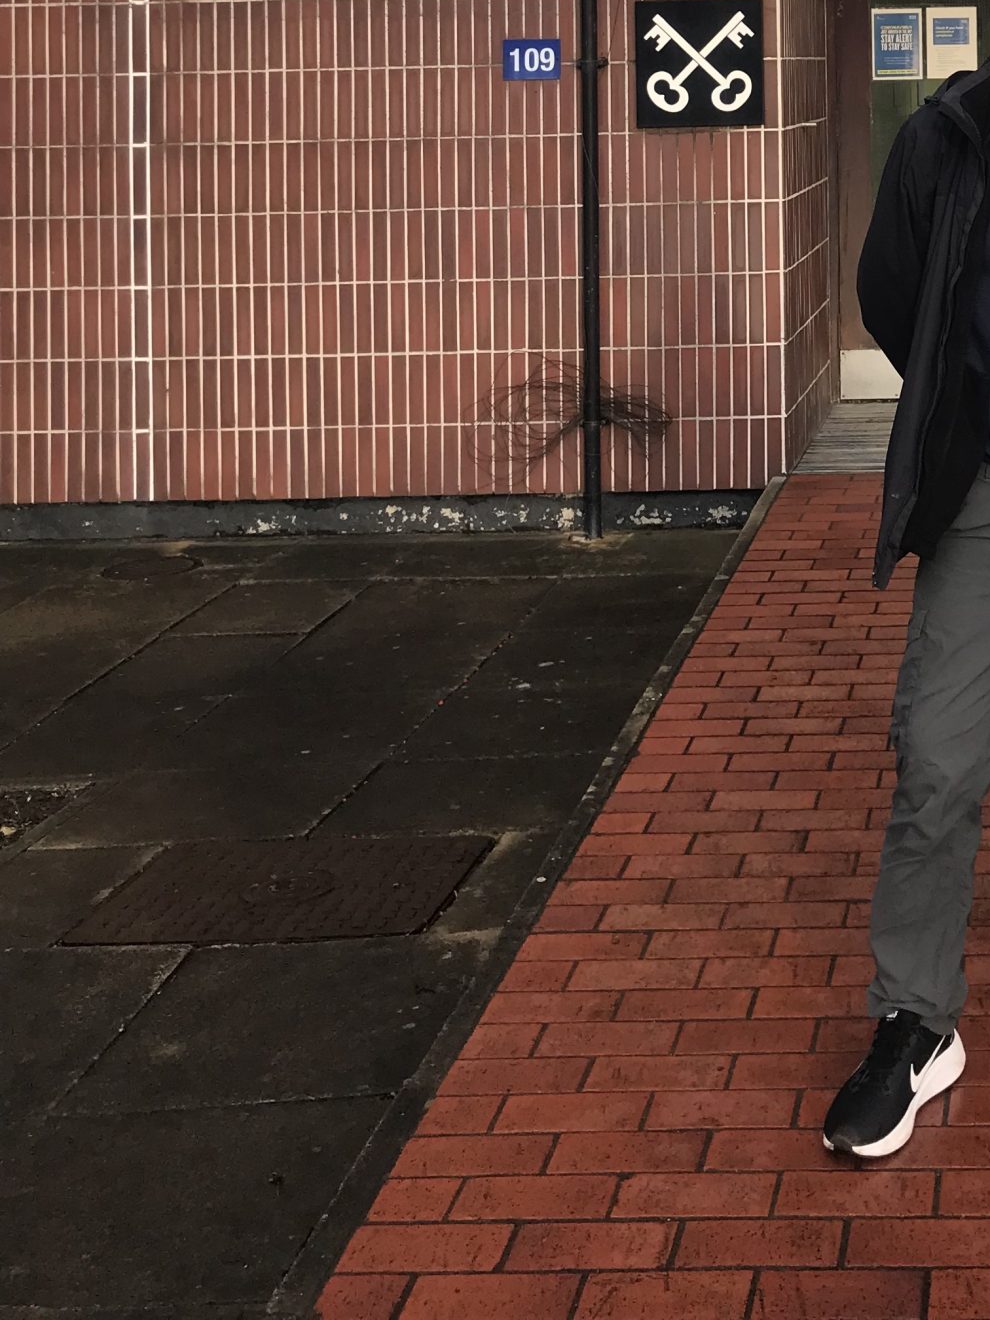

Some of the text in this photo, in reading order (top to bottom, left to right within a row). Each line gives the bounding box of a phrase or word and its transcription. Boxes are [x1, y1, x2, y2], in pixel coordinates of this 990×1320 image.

[880, 34, 912, 42] STAY ALERT
[881, 42, 913, 51] TO STAY SAFE
[509, 47, 555, 71] 109
